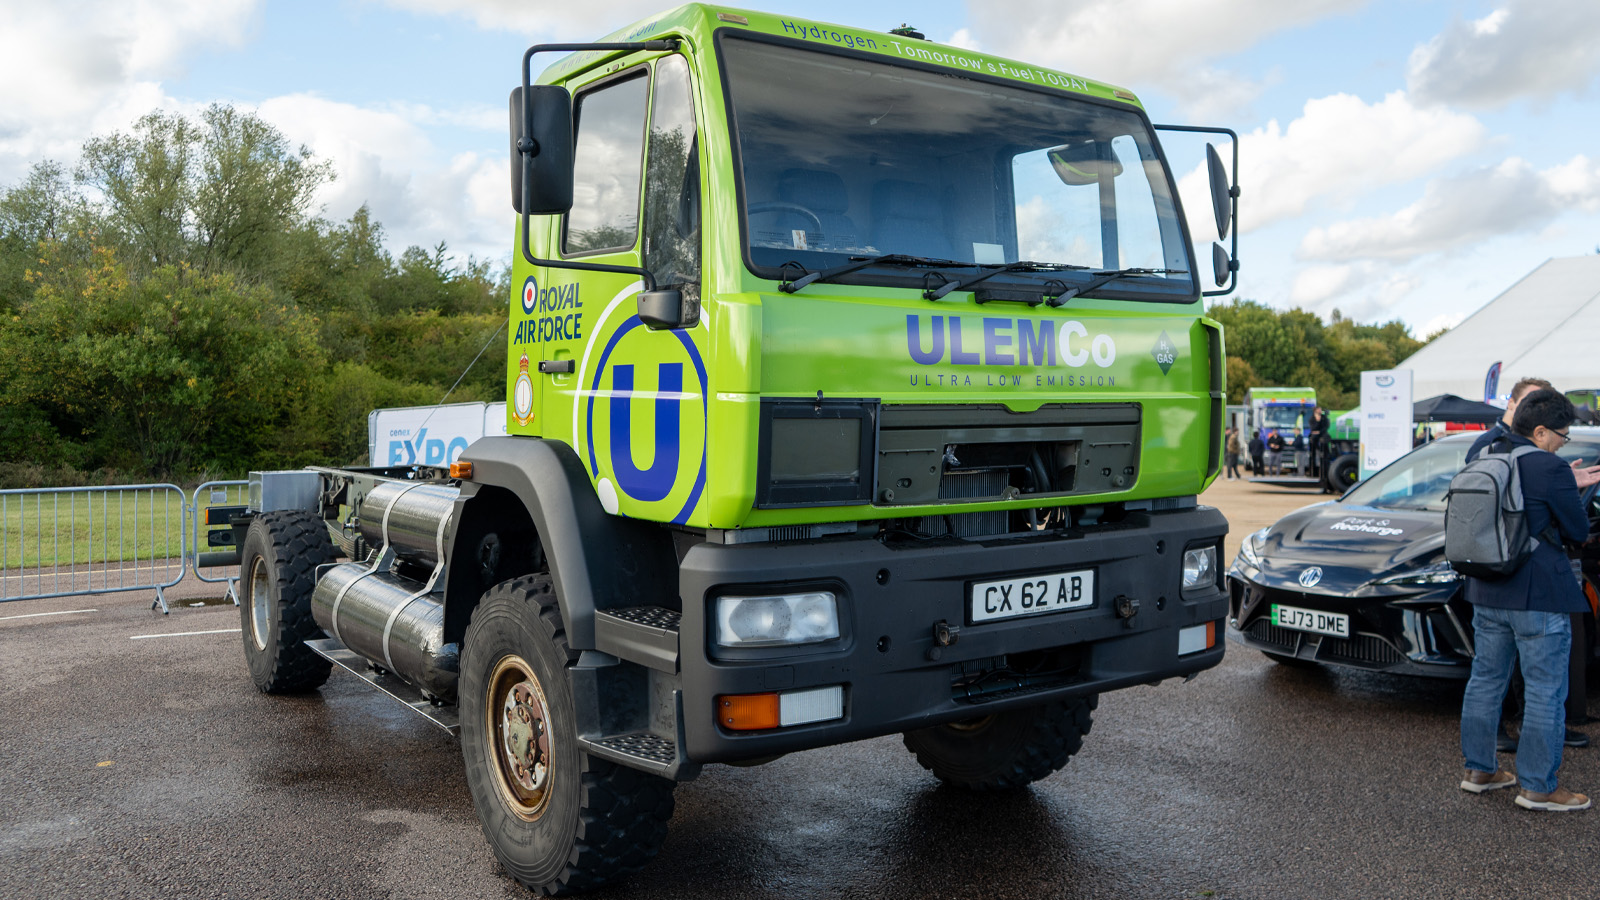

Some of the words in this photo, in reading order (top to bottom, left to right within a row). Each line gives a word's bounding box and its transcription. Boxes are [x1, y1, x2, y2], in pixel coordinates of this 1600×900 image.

[781, 20, 877, 49] Hydrogen
[890, 41, 997, 73] Tomorrow's
[998, 63, 1035, 81] Fuel
[1036, 71, 1089, 92] TODAY
[539, 282, 583, 313] ROYAL
[513, 320, 536, 345] AIR
[538, 313, 583, 342] FORCE
[906, 314, 1116, 368] ULEMCo
[1157, 353, 1174, 364] GAS
[910, 375, 972, 386] ULTRA
[987, 375, 1021, 386] LOW
[1036, 375, 1115, 387] EMISSION
[389, 429, 410, 437] cenex
[610, 363, 683, 502] U
[1330, 522, 1404, 536] Recharge
[1299, 566, 1323, 587] MG
[985, 584, 1013, 614] CX
[1021, 580, 1048, 608] 62
[1057, 576, 1083, 604] AB
[1280, 608, 1314, 628] EJ73
[1318, 614, 1345, 633] DME
